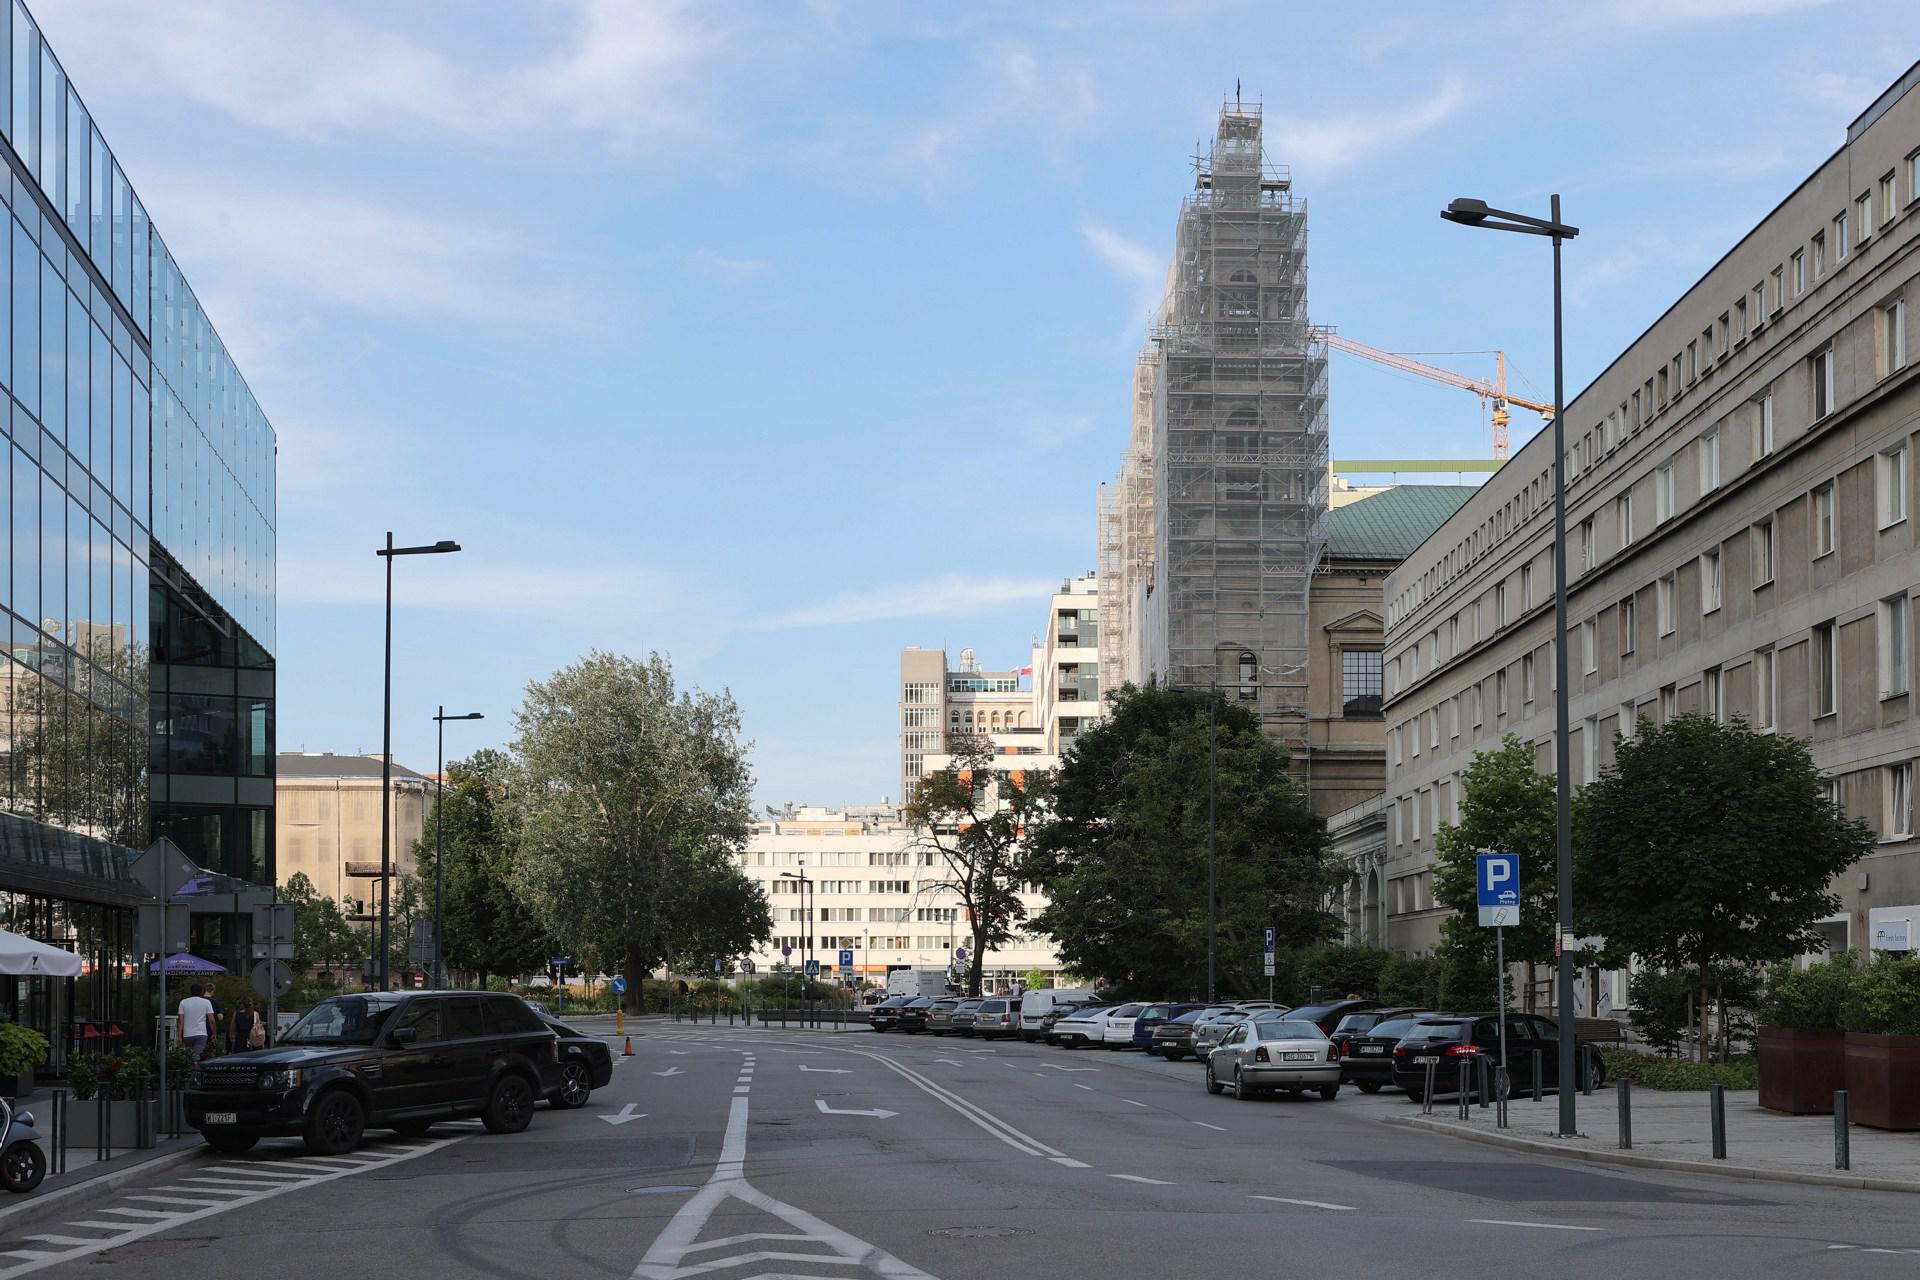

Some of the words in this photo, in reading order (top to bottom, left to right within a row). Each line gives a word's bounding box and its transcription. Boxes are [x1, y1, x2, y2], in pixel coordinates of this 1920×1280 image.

[1487, 859, 1510, 891] P
[1265, 930, 1272, 946] P
[842, 951, 851, 964] P
